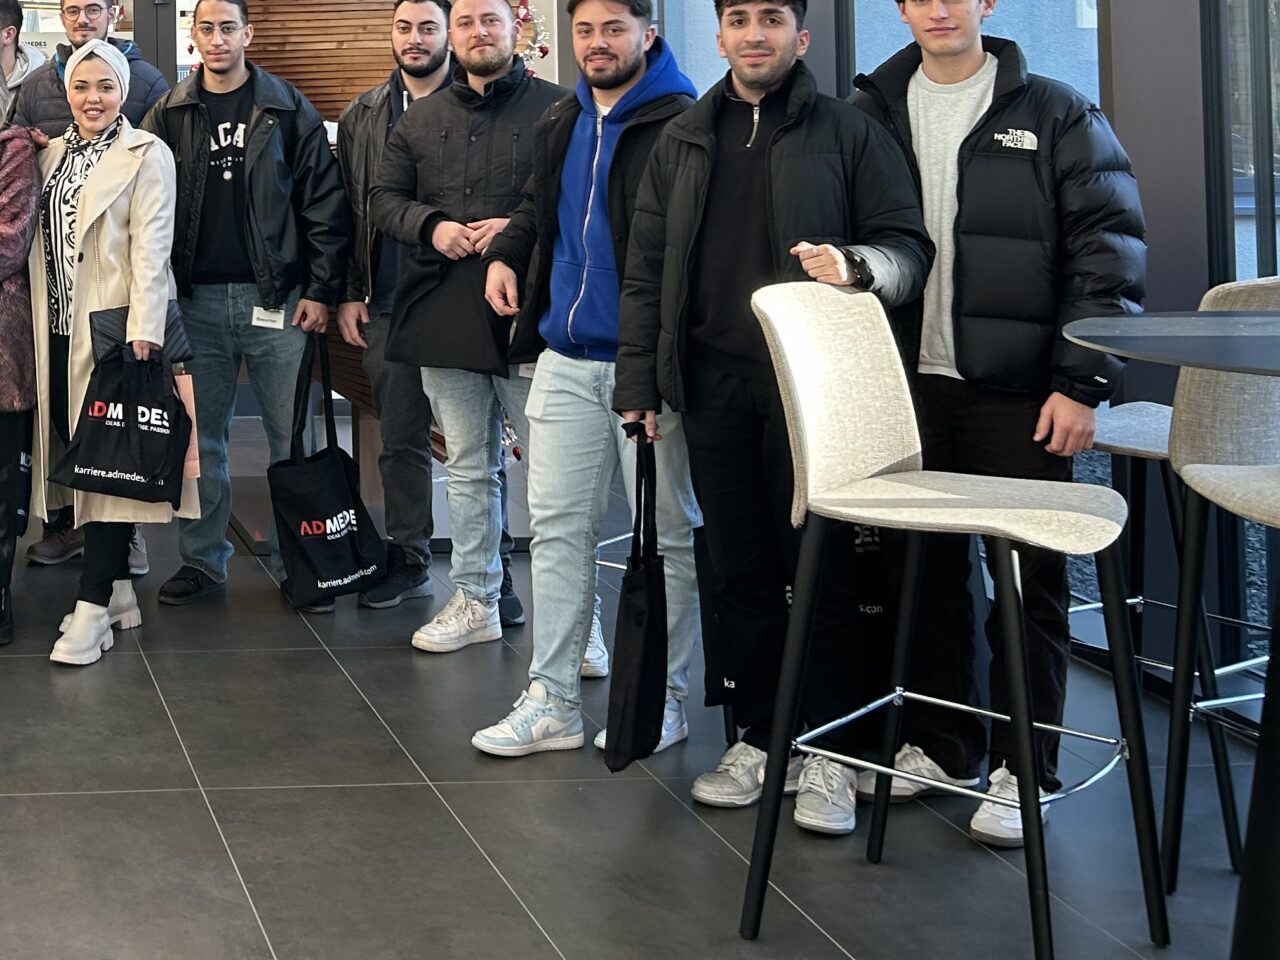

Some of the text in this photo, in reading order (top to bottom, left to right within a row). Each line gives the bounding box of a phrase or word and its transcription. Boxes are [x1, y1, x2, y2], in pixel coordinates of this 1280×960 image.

[994, 133, 1024, 142] NORTH
[1007, 128, 1024, 136] THE
[1002, 140, 1024, 148] FACE
[88, 401, 170, 428] DMDES
[74, 465, 164, 486] karriere.admedes.m
[300, 509, 357, 536] ADMEDE
